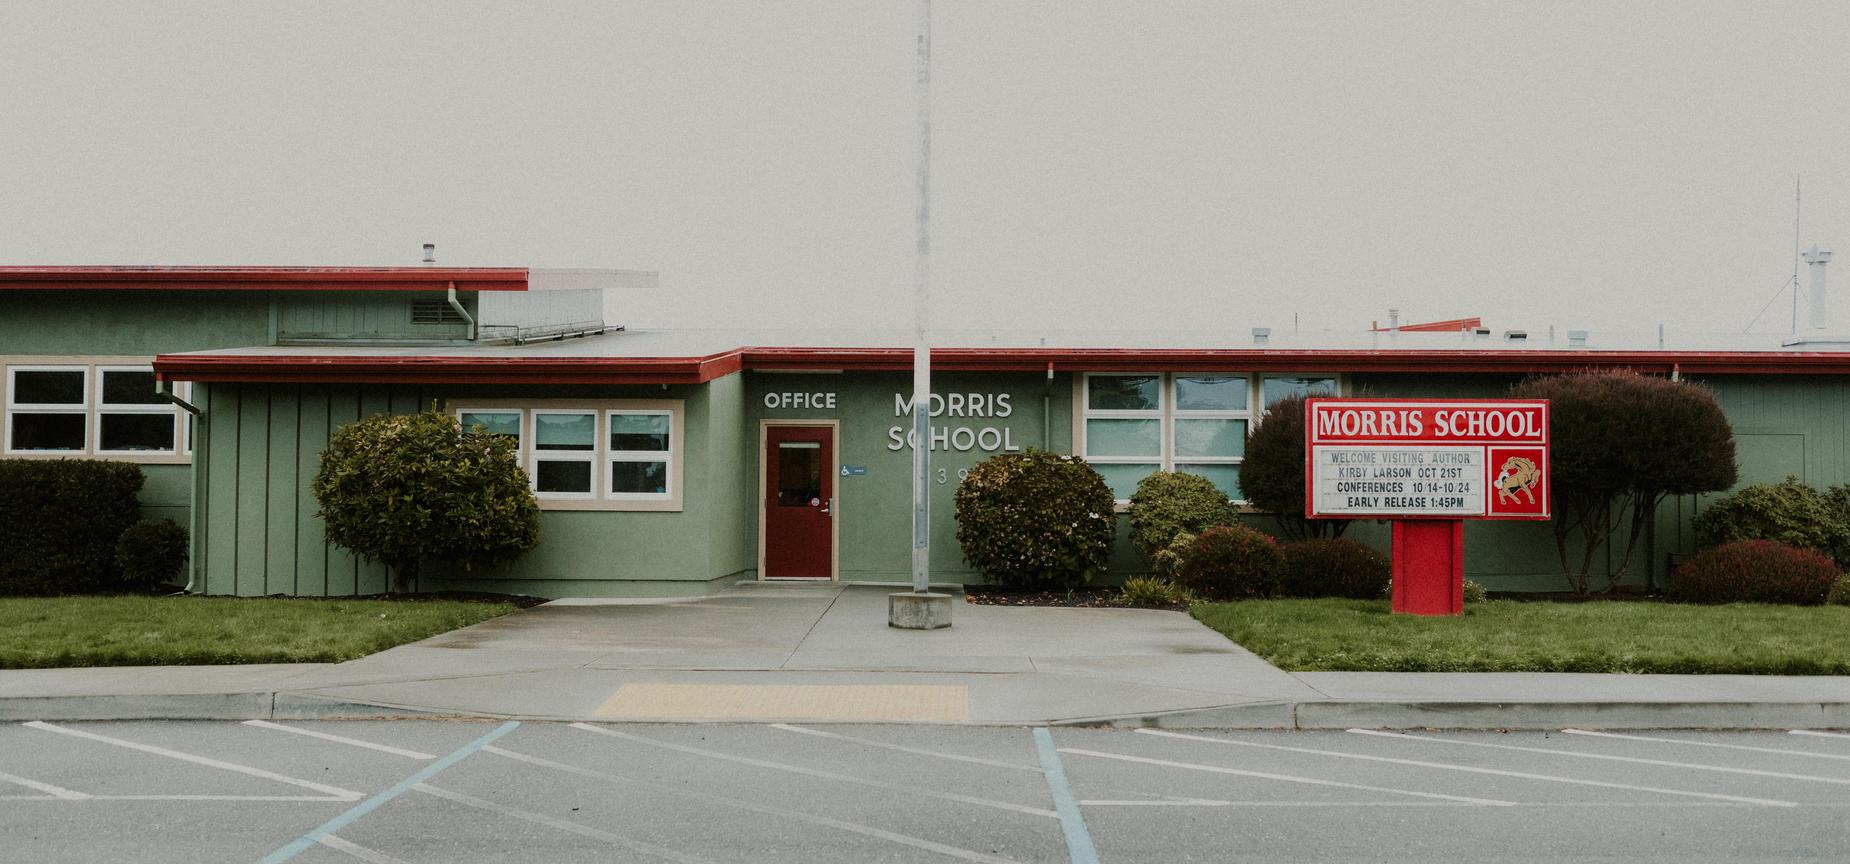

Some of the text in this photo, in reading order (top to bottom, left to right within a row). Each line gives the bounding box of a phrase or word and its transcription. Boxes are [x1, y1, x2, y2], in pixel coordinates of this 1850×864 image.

[764, 392, 836, 409] OFFICE
[895, 393, 1012, 417] MORRIS
[1319, 410, 1541, 437] MORRIS SCHOOL
[1331, 453, 1470, 464] WELCOME VISITING AUTHOR
[1338, 467, 1462, 478] KIRBY LARSON OCT 21ST
[1337, 482, 1470, 493] CONFERENCES 10/14-10/24
[1348, 497, 1464, 508] EARLY RELEASE 1:45PM
